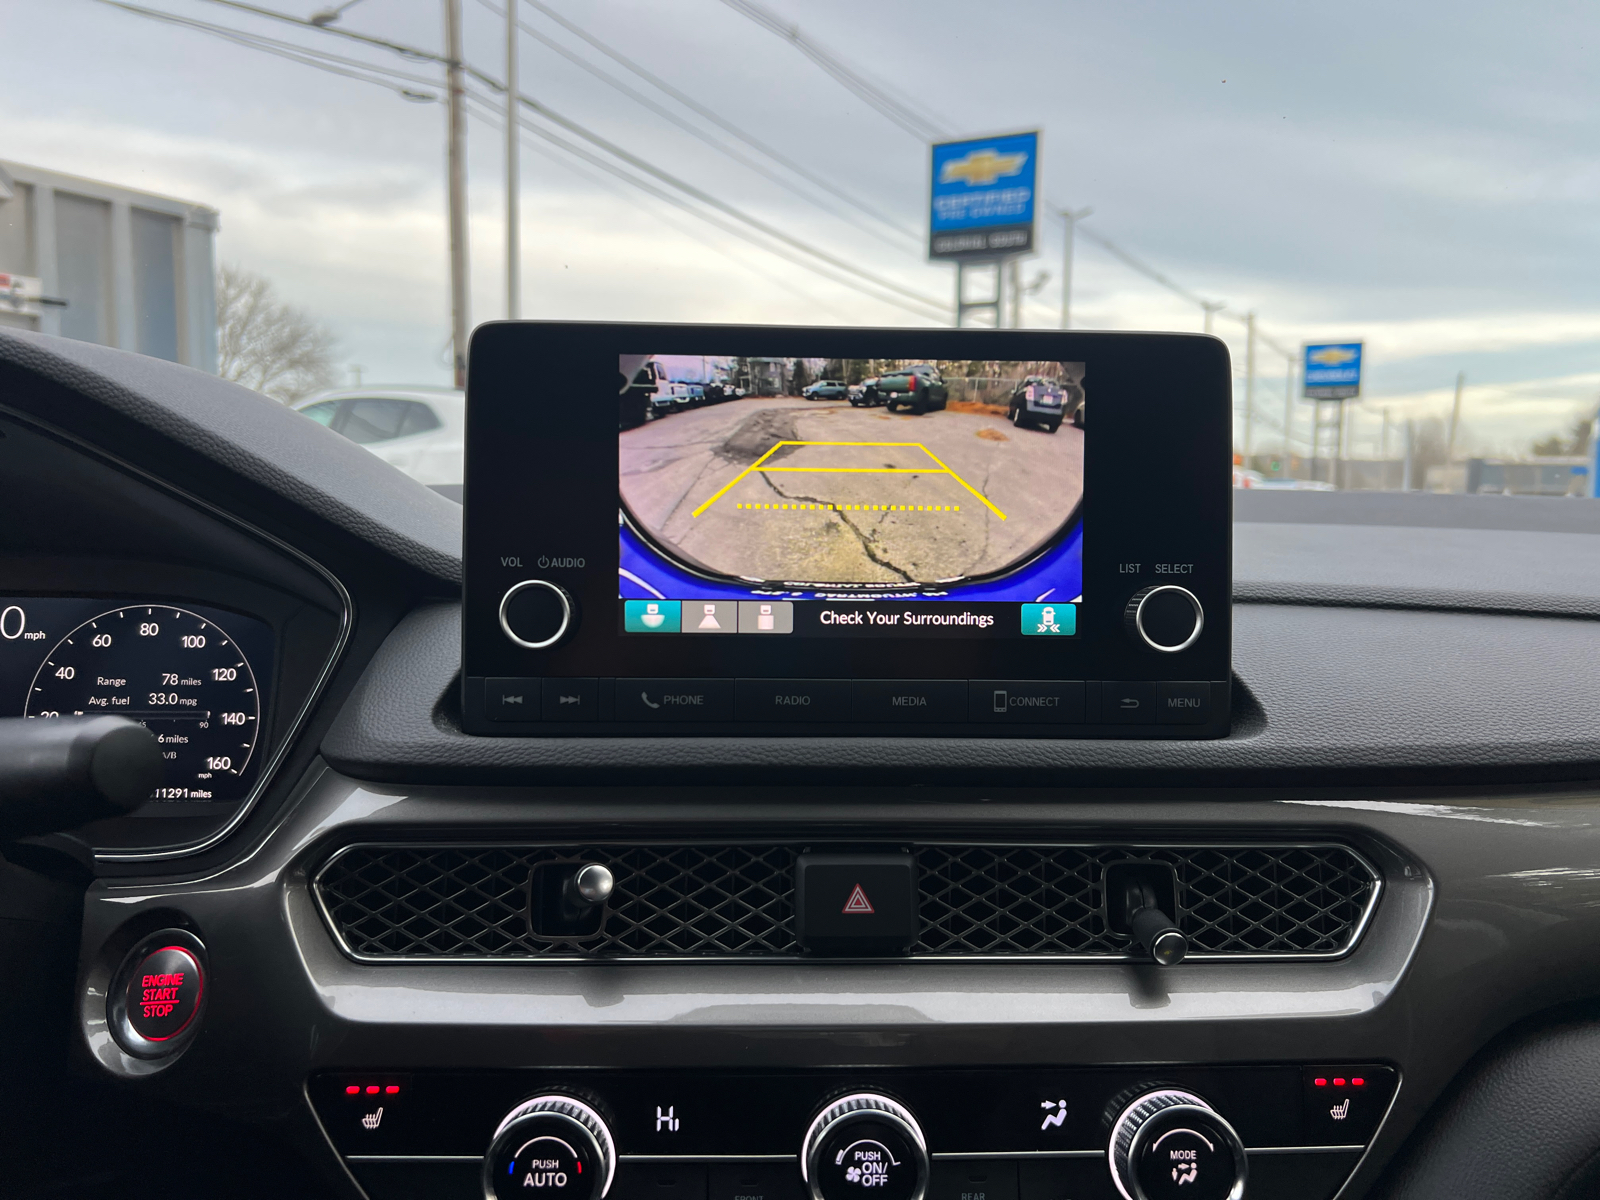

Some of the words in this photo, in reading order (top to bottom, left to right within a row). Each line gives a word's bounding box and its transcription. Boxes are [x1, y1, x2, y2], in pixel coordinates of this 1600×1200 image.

[500, 557, 523, 568] VOL
[551, 556, 585, 568] AUDIO
[1119, 563, 1141, 574] LIST
[1155, 563, 1194, 574] SELECT
[0, 605, 25, 640] 0
[24, 630, 46, 641] mph
[820, 610, 862, 625] Check
[866, 611, 901, 626] Your
[903, 611, 994, 628] Surroundings
[139, 623, 159, 636] 80
[92, 634, 112, 648] 60
[182, 636, 206, 649] 100
[55, 667, 75, 680] 40
[162, 673, 179, 686] 78
[180, 677, 202, 686] miles
[212, 668, 237, 681] 120
[97, 677, 126, 687] Range
[88, 696, 109, 706] Avg.
[112, 696, 130, 705] fuel
[148, 693, 178, 705] 33.0
[179, 697, 198, 707] mpg
[663, 694, 704, 706] PHONE
[775, 695, 811, 706] RADIO
[892, 696, 927, 707] MEDIA
[1009, 696, 1060, 708] CONNECT
[1168, 697, 1201, 708] MENU
[222, 712, 246, 725] 140
[199, 721, 209, 729] 90
[165, 735, 189, 744] miles
[207, 757, 231, 770] 160
[190, 789, 213, 798] miles
[142, 973, 184, 987] ENGINE
[142, 988, 179, 1001] START
[143, 1004, 173, 1018] STOP
[854, 1150, 882, 1161] PUSH
[1170, 1150, 1197, 1161] MODE
[532, 1159, 559, 1169] PUSH
[862, 1160, 889, 1175] ON/
[523, 1172, 568, 1188] AUTO
[862, 1174, 888, 1187] OFF
[961, 1192, 986, 1200] REAR
